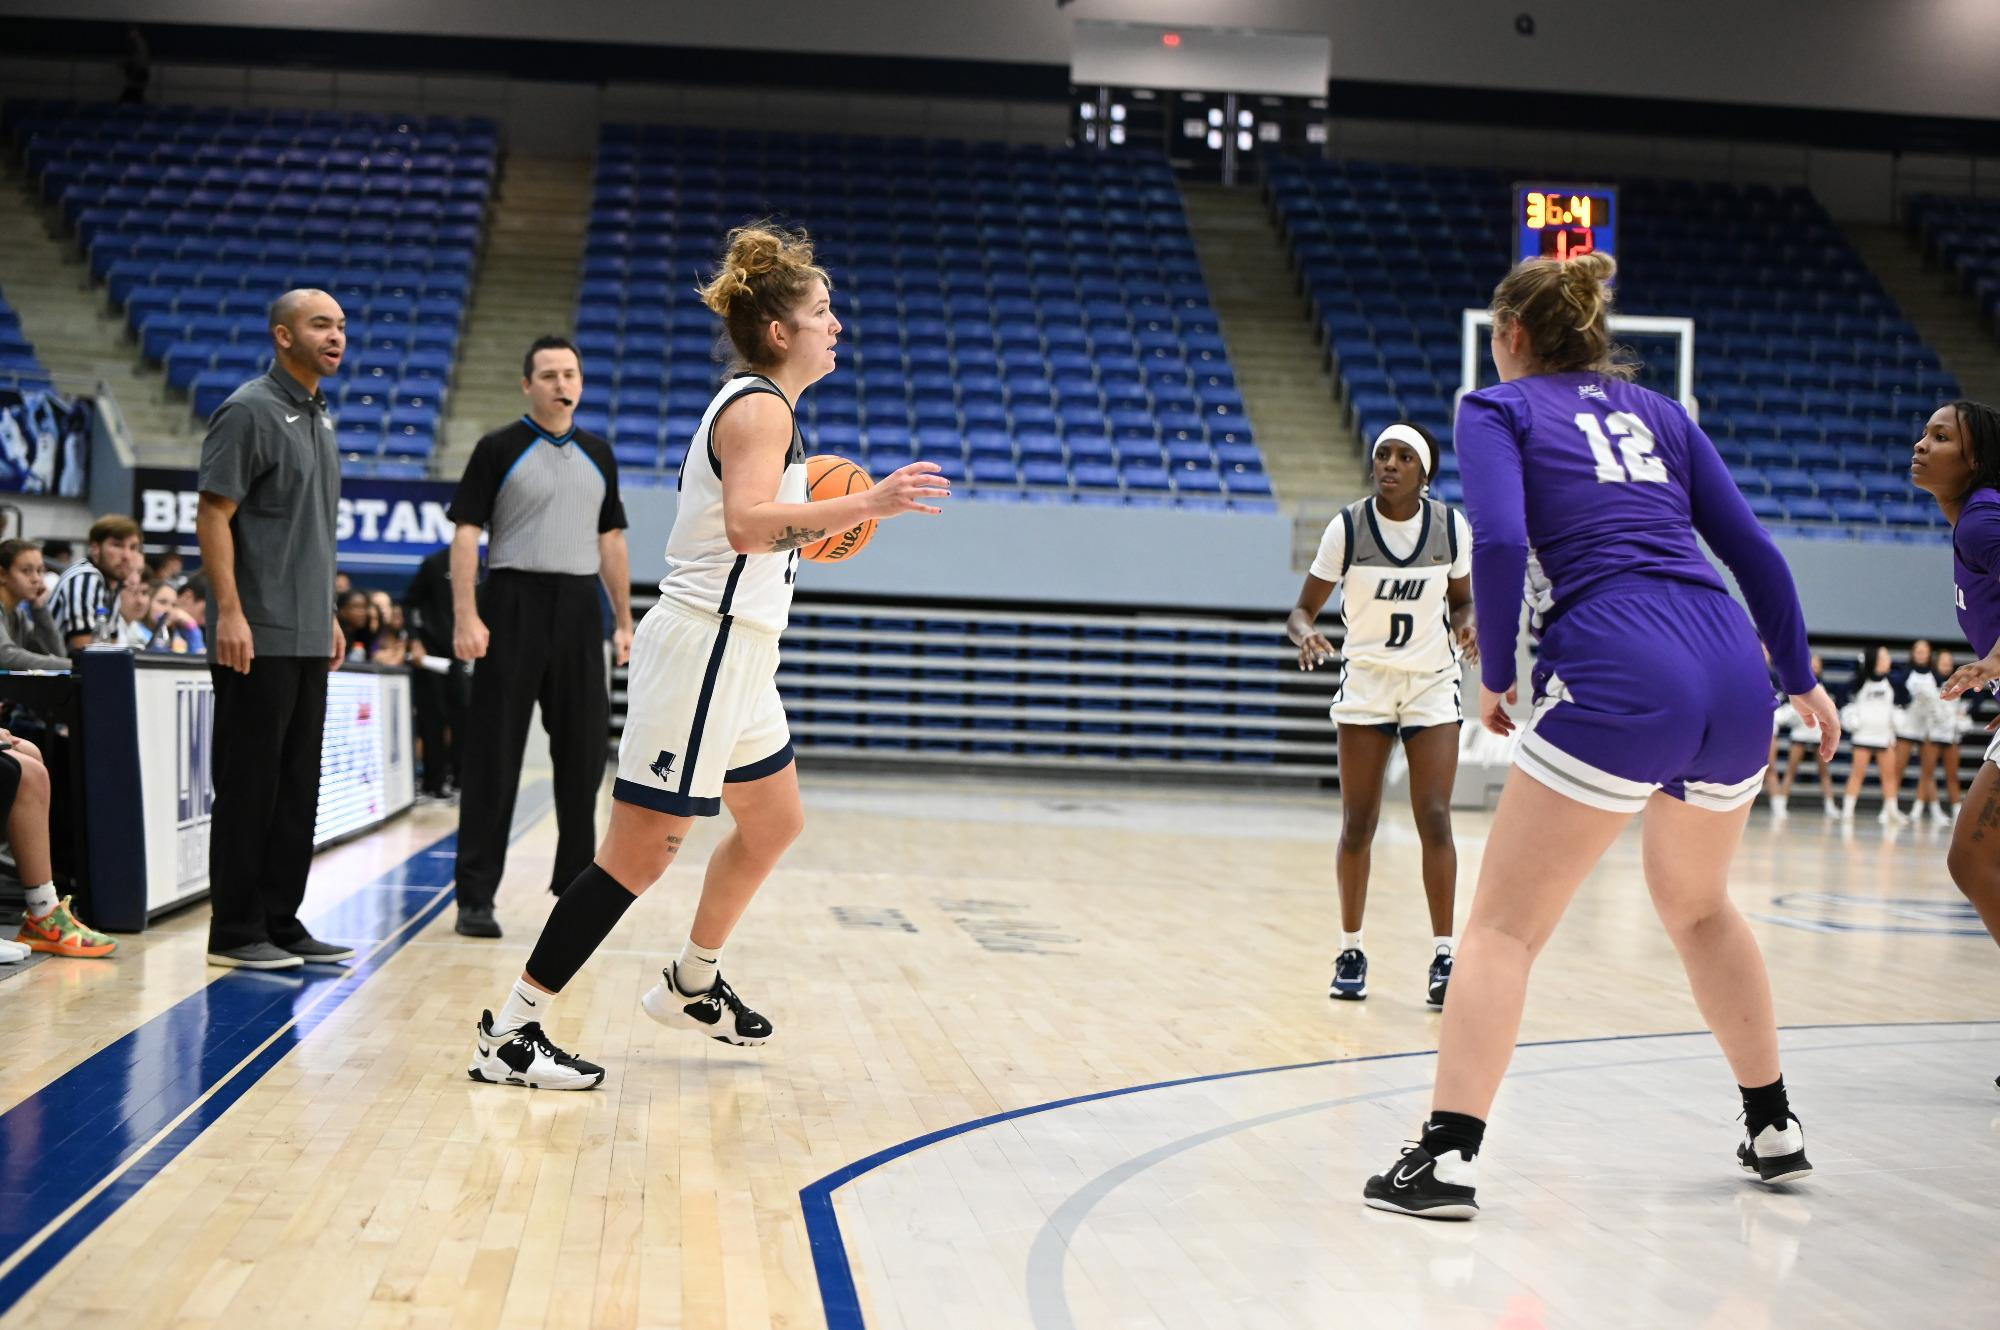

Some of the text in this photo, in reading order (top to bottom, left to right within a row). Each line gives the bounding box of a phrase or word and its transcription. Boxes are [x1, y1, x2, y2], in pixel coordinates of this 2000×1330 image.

[1527, 192, 1591, 228] 36.4
[1557, 227, 1594, 261] 12
[1574, 411, 1669, 484] 12
[335, 499, 488, 546] STAN
[825, 521, 864, 559] Wils
[1374, 578, 1430, 601] LMU
